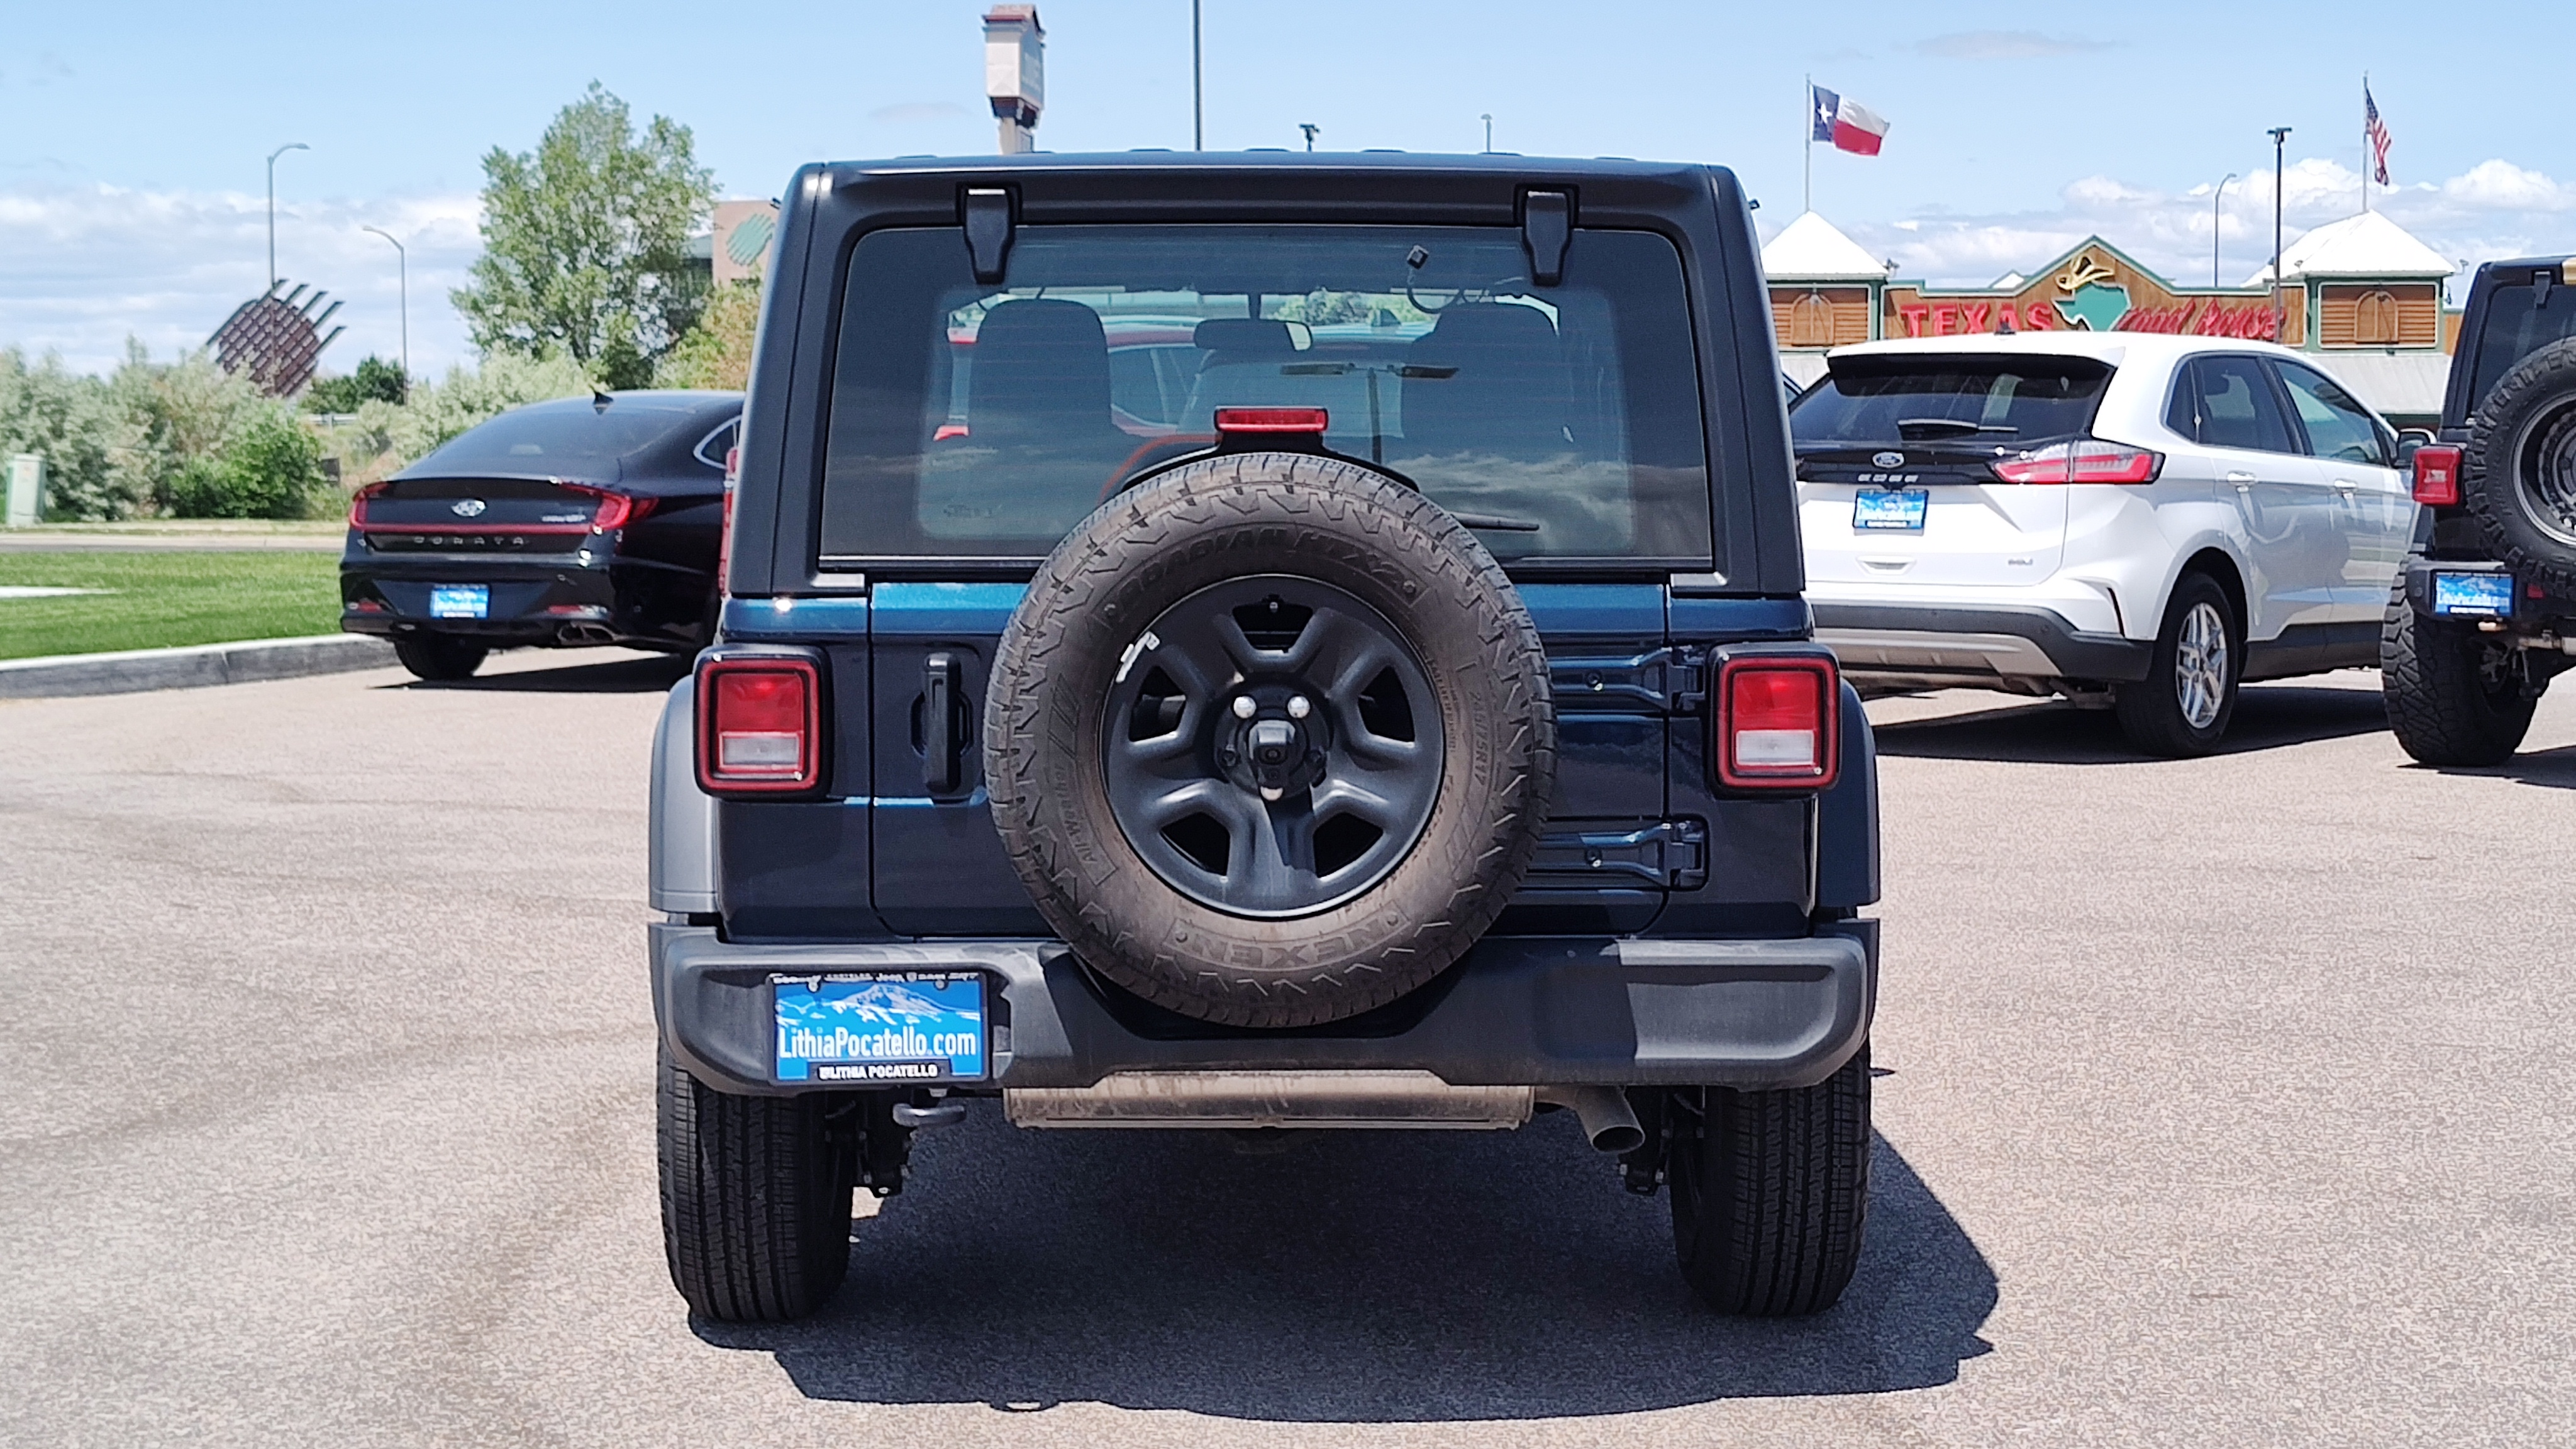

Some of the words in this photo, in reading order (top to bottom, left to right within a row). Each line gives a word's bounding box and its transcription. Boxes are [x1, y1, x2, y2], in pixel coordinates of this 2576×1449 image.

[1900, 301, 2054, 337] TEXAS
[1193, 918, 1387, 969] NEXEN
[779, 1025, 977, 1059] LithiaPocatello.com
[830, 1065, 868, 1080] LITHIA
[868, 1063, 938, 1078] POCATELLO
